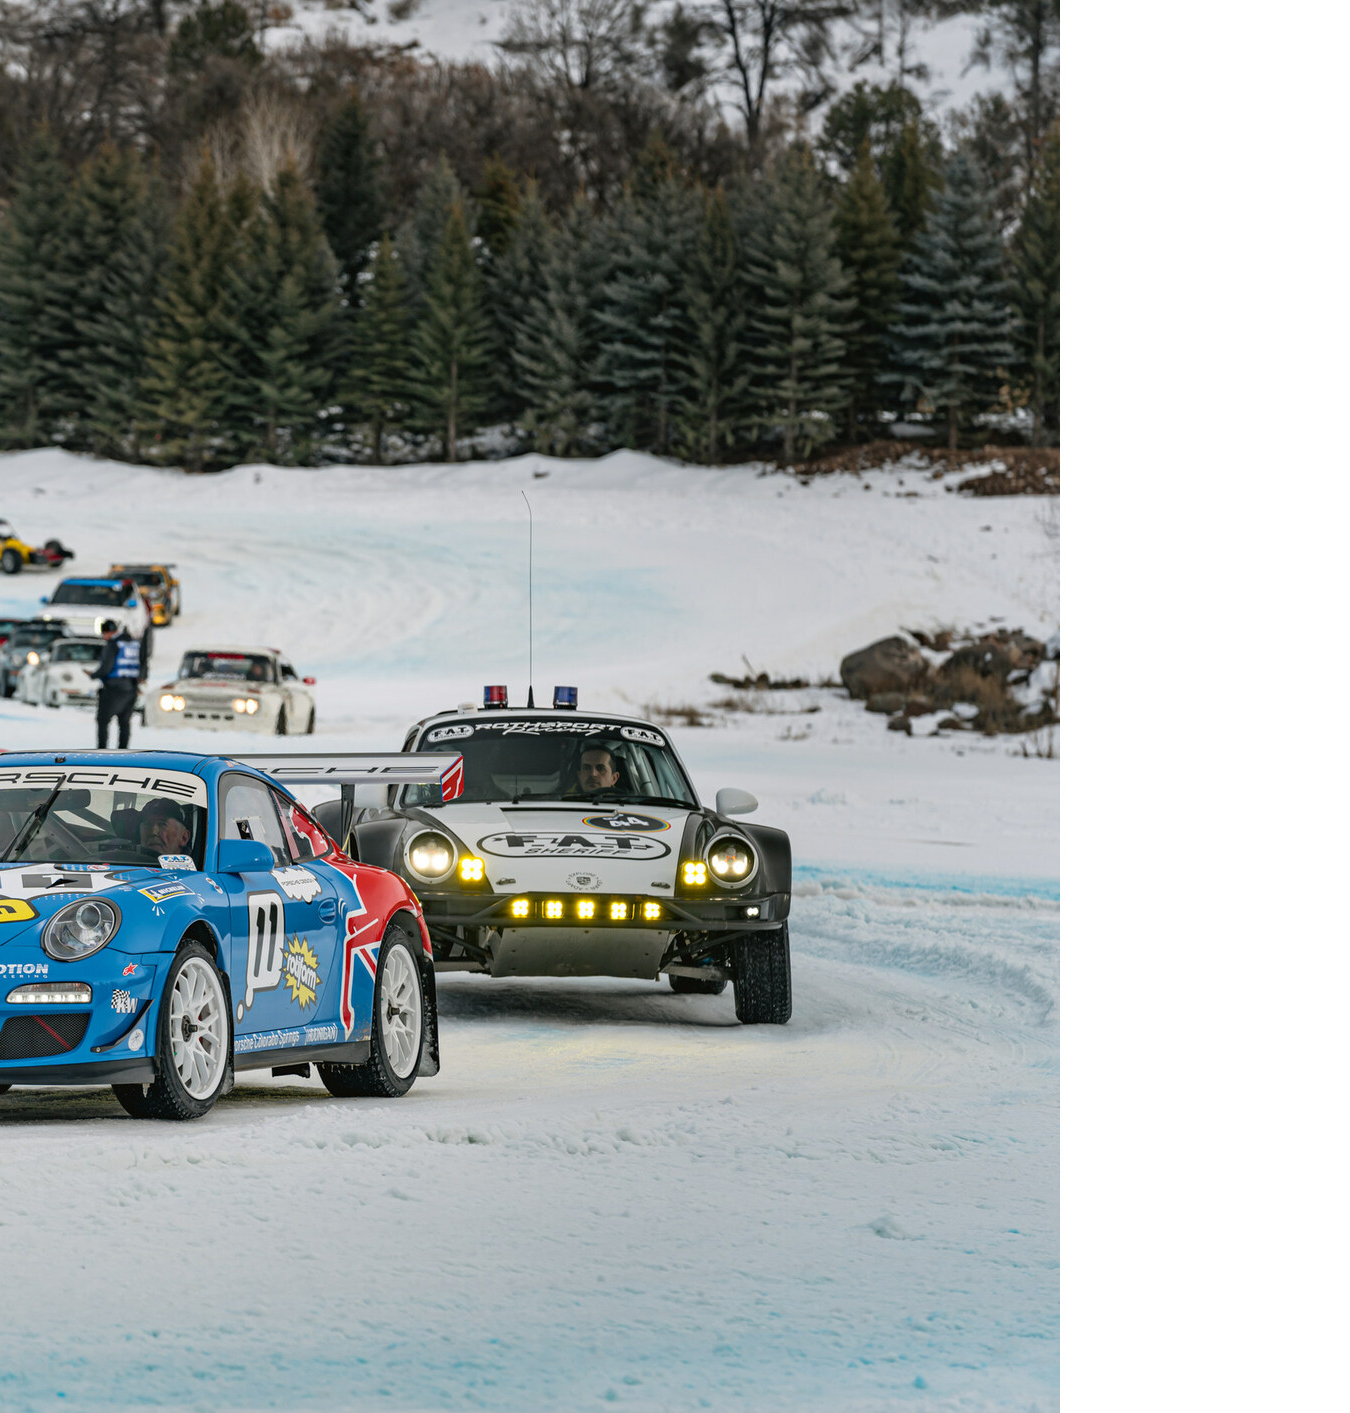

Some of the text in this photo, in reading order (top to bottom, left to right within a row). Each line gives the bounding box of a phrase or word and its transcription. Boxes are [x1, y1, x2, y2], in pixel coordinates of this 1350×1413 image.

[475, 721, 622, 731] ROTHSPORT
[524, 847, 631, 855] SHERIFF
[157, 885, 186, 894] MICHELIN
[253, 901, 278, 978] 11
[286, 952, 317, 990] rotiform
[116, 998, 139, 1014] KW
[234, 1029, 300, 1052] orsche Colorado Springs
